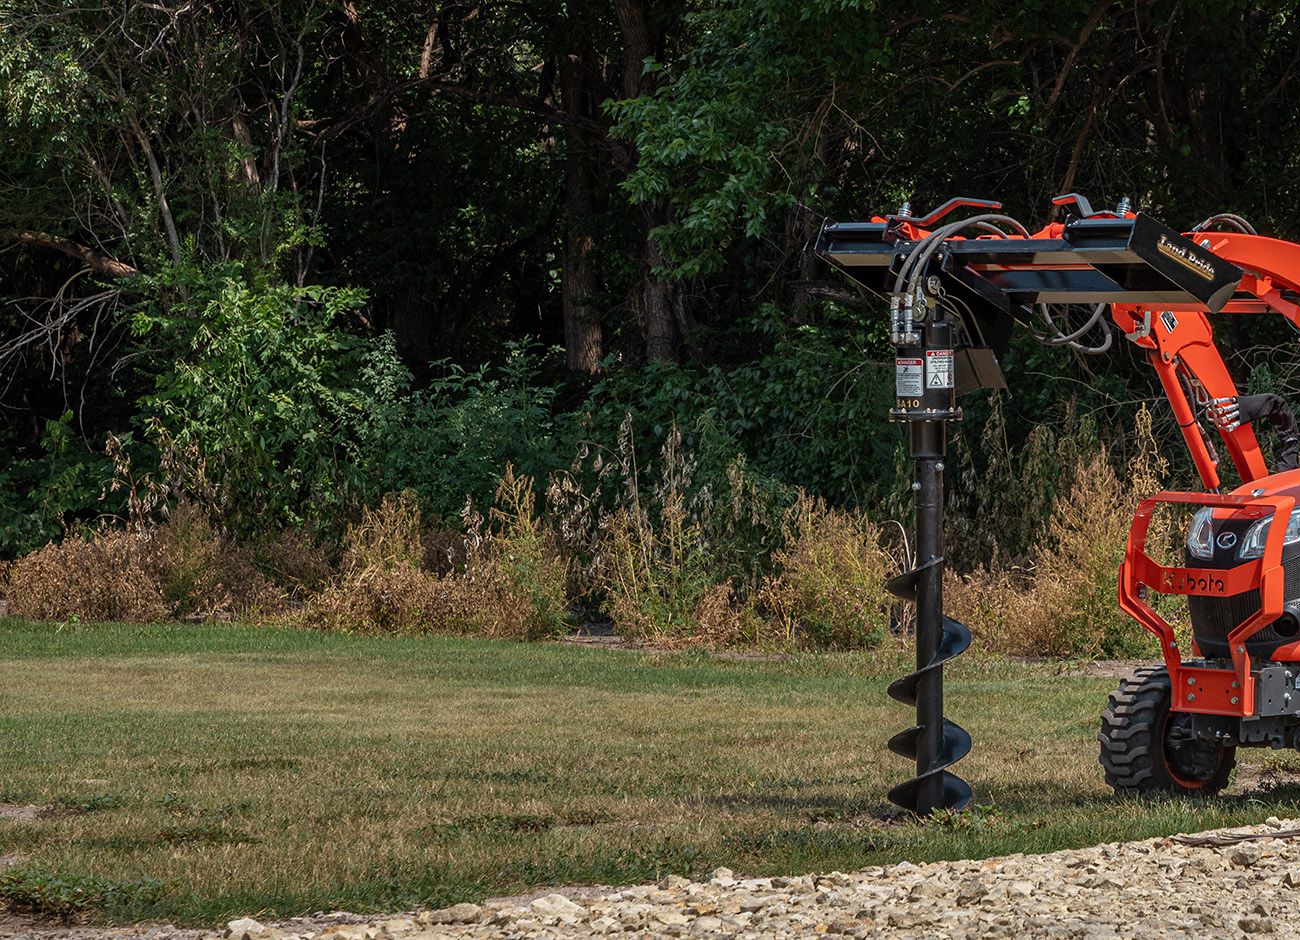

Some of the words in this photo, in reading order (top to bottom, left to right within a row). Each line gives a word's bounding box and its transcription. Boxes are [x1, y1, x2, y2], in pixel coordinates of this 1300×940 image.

[1160, 234, 1186, 256] Land
[1188, 252, 1215, 274] Pride
[897, 399, 920, 408] SA10
